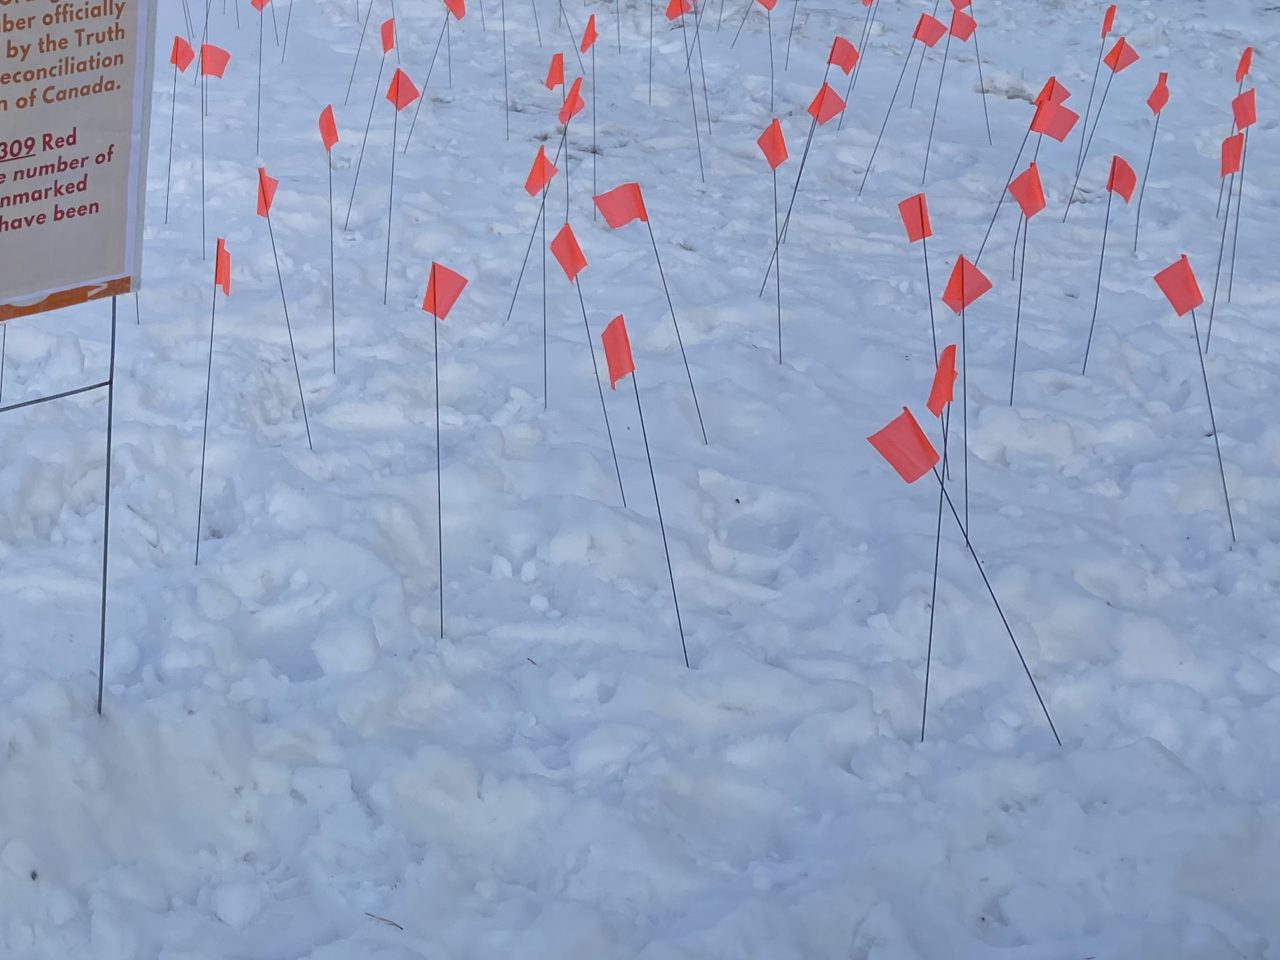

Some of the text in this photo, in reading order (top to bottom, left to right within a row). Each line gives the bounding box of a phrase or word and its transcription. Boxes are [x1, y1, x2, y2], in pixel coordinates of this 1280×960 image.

[6, 39, 31, 62] by
[38, 33, 68, 54] the
[74, 22, 125, 47] Truth
[16, 92, 36, 110] of
[42, 75, 121, 104] Canada.
[42, 127, 77, 152] Red
[13, 153, 89, 182] number
[95, 144, 115, 164] of
[53, 201, 100, 222] been
